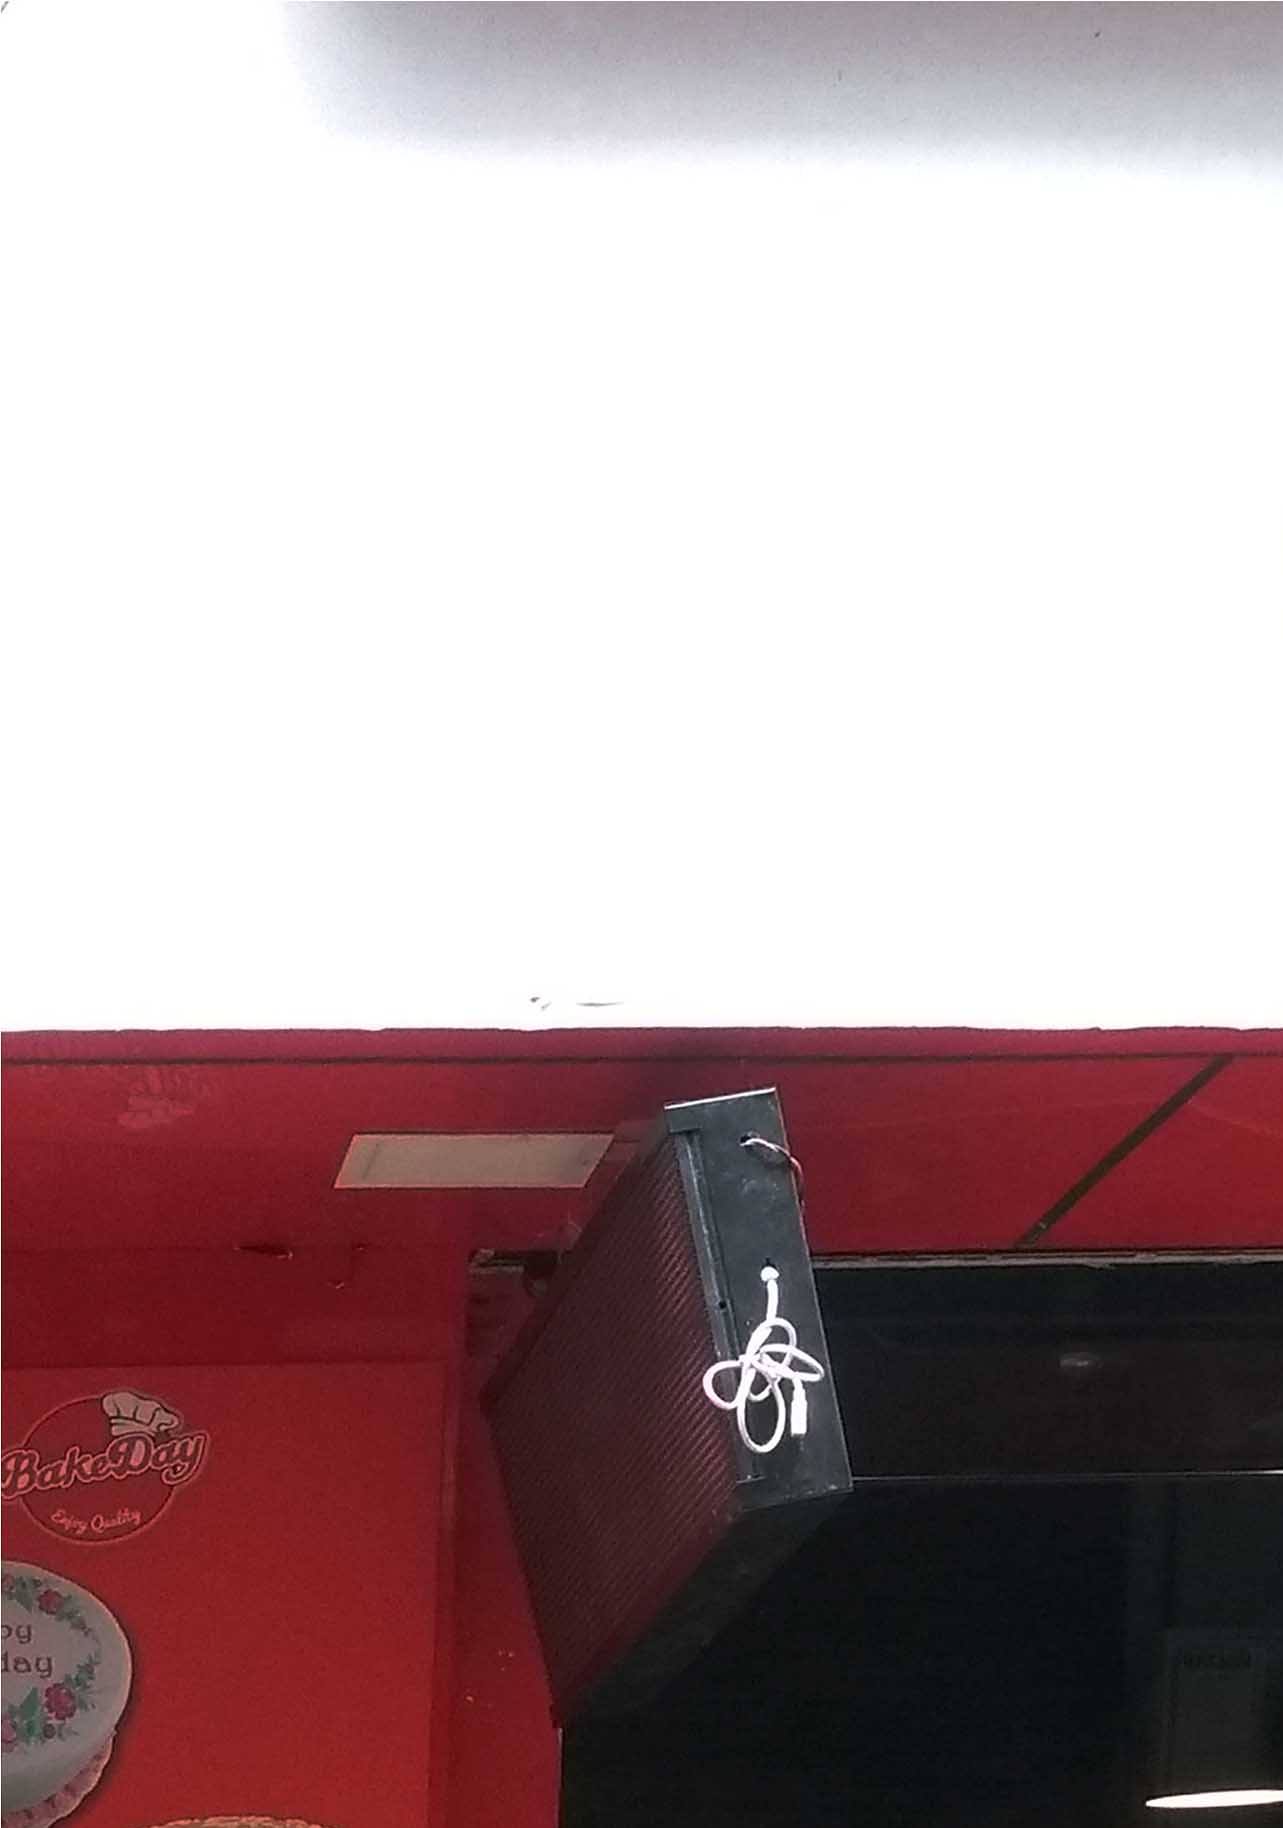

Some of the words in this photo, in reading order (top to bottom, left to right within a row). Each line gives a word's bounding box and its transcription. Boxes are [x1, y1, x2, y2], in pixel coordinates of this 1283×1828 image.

[1, 1433, 206, 1499] BakeDay
[51, 1509, 88, 1534] Enjoy
[90, 1508, 142, 1533] Quality
